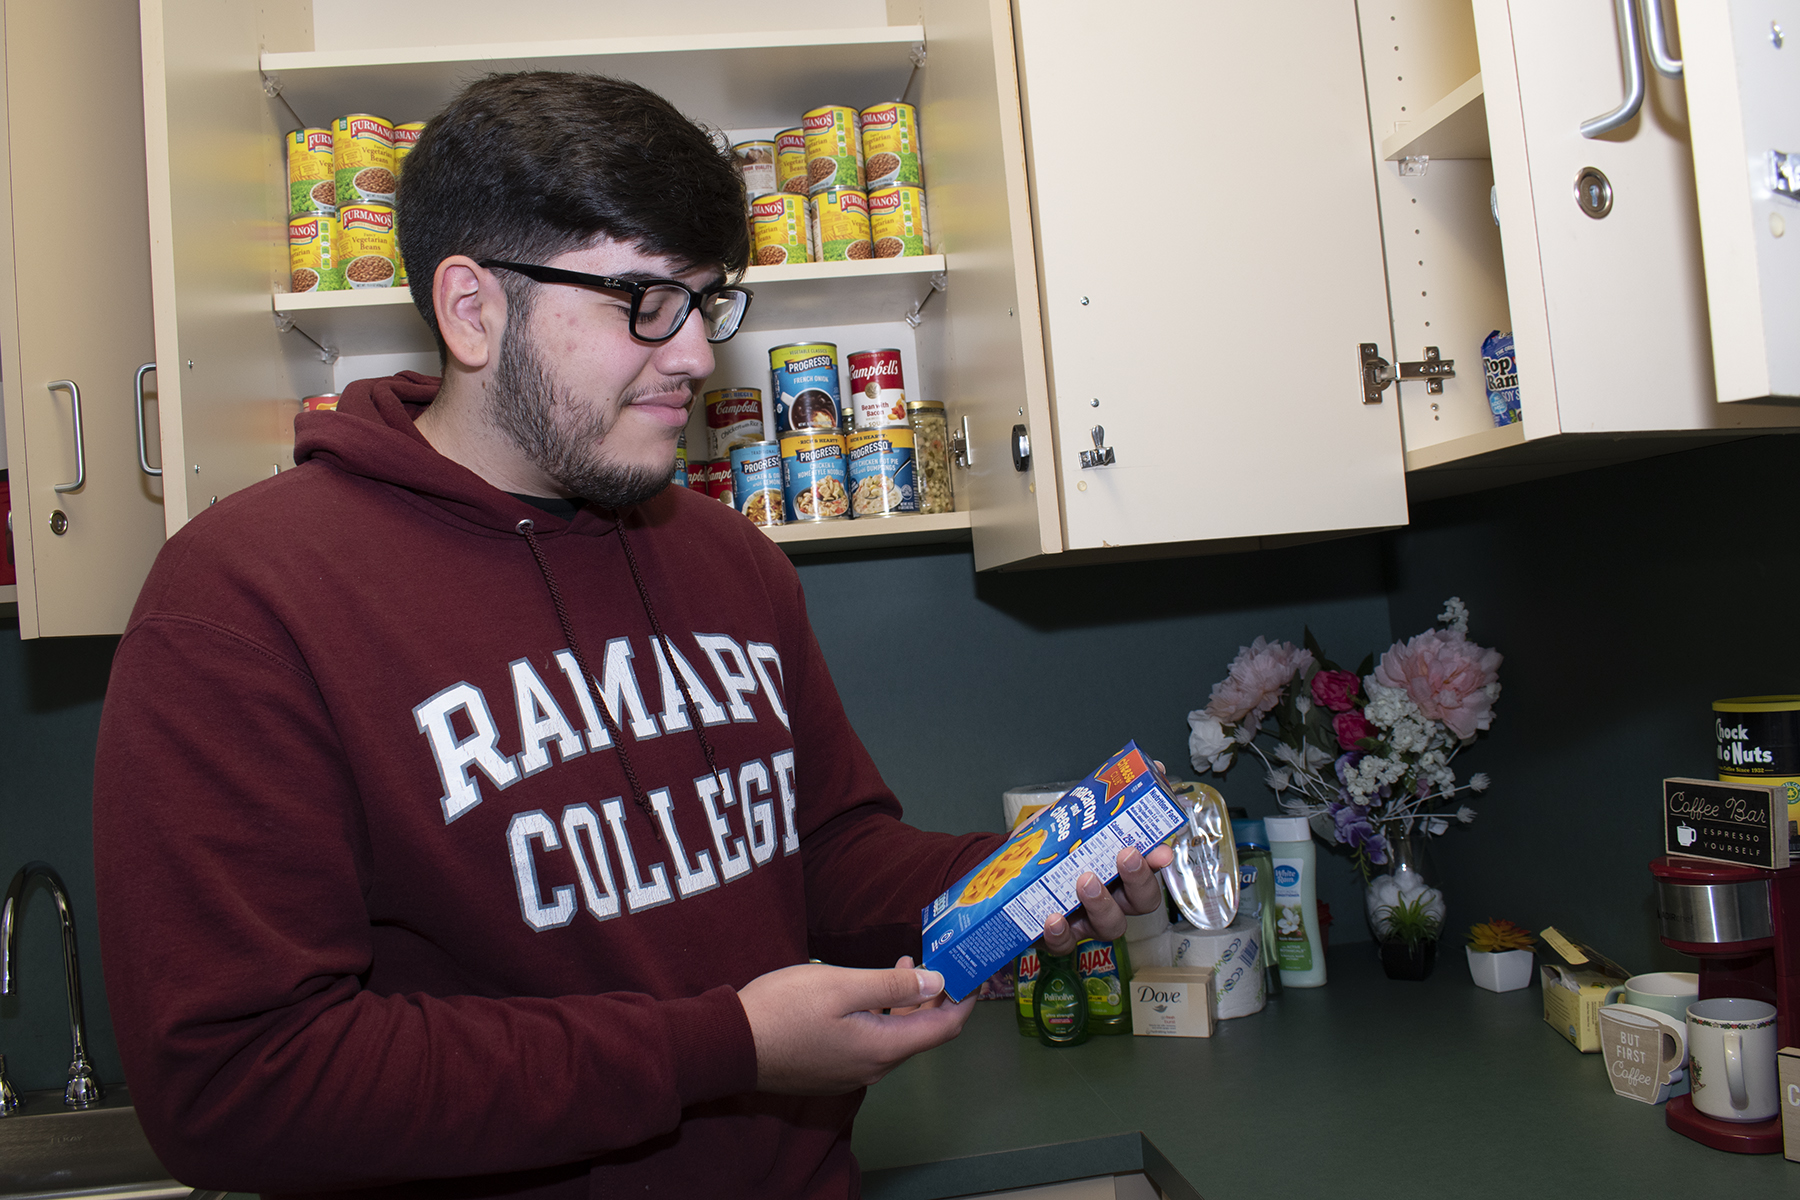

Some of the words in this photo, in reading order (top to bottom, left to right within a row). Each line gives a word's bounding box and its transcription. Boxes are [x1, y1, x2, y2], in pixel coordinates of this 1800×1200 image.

[370, 154, 388, 164] Beans
[344, 209, 392, 227] FURMANO'S
[352, 236, 388, 244] Vegetarian
[788, 356, 830, 372] PROGRESSO
[850, 360, 898, 380] Campbell's
[1483, 357, 1512, 376] Top
[794, 376, 814, 384] FRENCH
[1502, 390, 1515, 402] SOY
[716, 401, 759, 415] Campbell's
[721, 425, 742, 440] Chicken
[800, 446, 840, 462] PROGRESSO
[850, 441, 888, 460] PROGRESSO
[826, 468, 844, 476] NOODLES
[1716, 718, 1750, 743] Chock
[1117, 757, 1135, 784] cheese
[1070, 786, 1098, 830] macaroni
[1070, 803, 1082, 816] and
[1148, 788, 1170, 812] Nutrition
[1165, 808, 1181, 825] Facts
[1670, 791, 1720, 820] Coffee
[1725, 797, 1766, 824] Bar
[1050, 804, 1070, 842] cheese
[1109, 820, 1126, 837] Calories
[1122, 832, 1135, 846] 250
[1704, 828, 1760, 842] ESPRESSO
[1704, 841, 1760, 856] YOURSELF
[1080, 946, 1112, 976] AJAX
[1098, 965, 1116, 974] ULTRA
[1044, 992, 1074, 1002] Palmolive
[1138, 985, 1180, 1004] Dove
[1620, 1031, 1640, 1048] BUT
[1616, 1044, 1646, 1064] FIRST
[1612, 1060, 1651, 1086] Coffee
